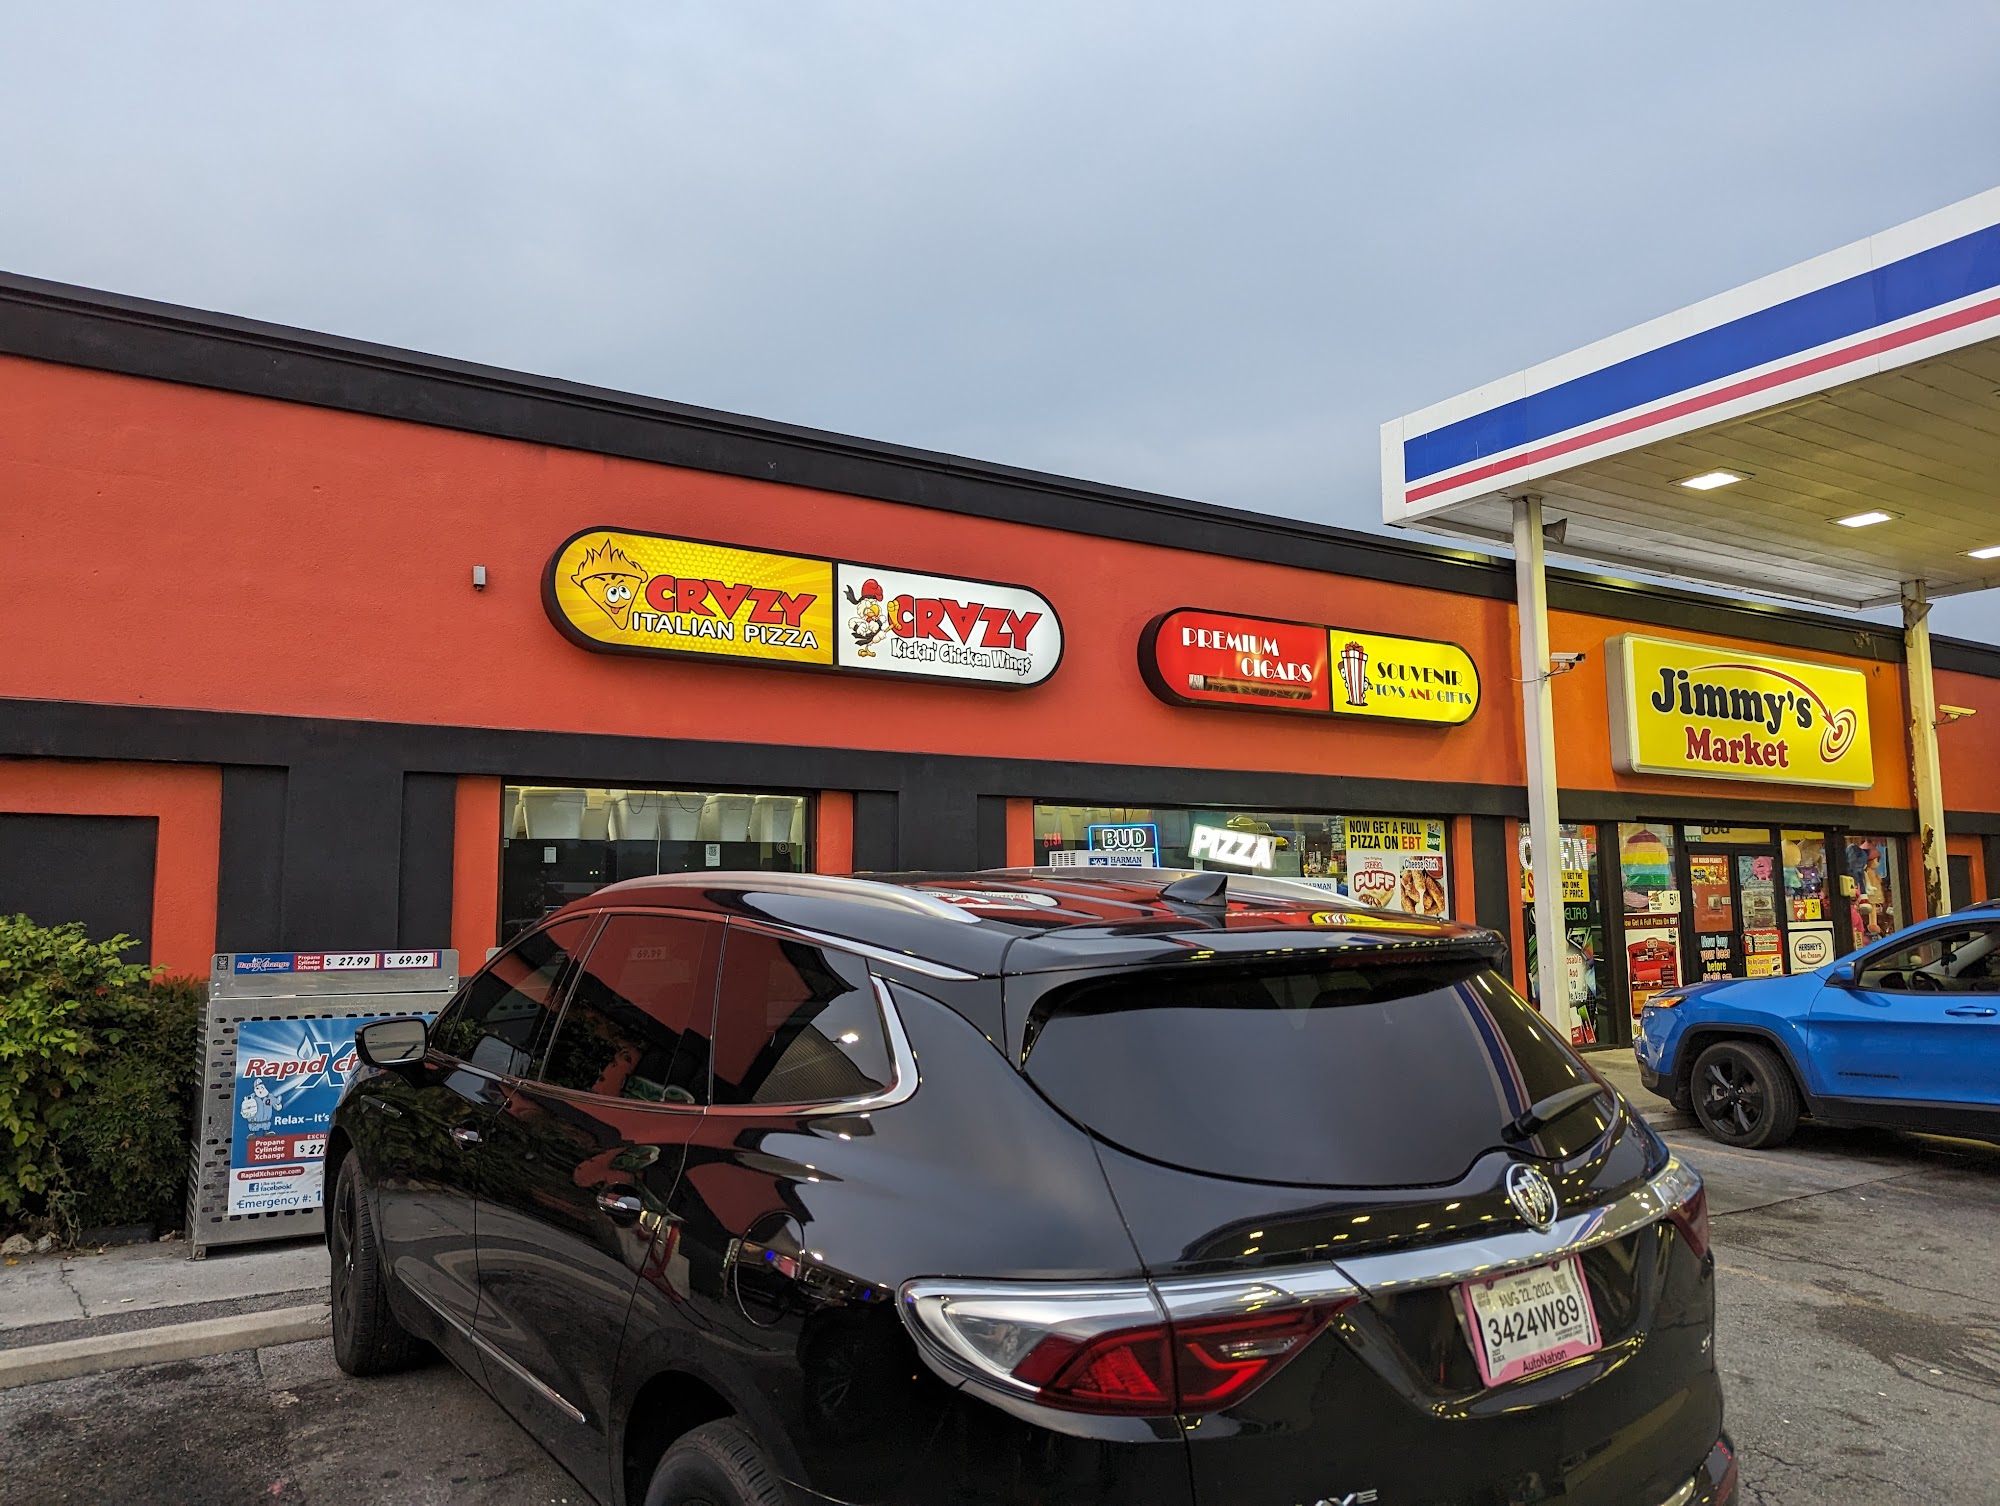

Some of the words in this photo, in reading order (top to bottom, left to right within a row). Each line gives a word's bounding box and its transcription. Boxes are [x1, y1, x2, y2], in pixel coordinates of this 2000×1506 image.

[645, 575, 817, 627] CRAZY
[632, 612, 734, 641] ITALIAN
[744, 625, 818, 649] PIZZA
[889, 594, 1042, 651] CRAZY
[1182, 627, 1279, 656] PREMIUM
[890, 637, 938, 661] Kickin'
[938, 643, 991, 668] Chicken
[991, 650, 1032, 676] Wings
[1241, 658, 1313, 683] CIGARS
[1377, 662, 1463, 687] SOUVENIR
[1374, 683, 1406, 699] TOYS
[1407, 687, 1434, 701] AND
[1436, 690, 1472, 705] GIFTS
[1651, 668, 1812, 735] Jimmy's
[1685, 726, 1789, 768] Market
[1349, 820, 1370, 834] NOW
[1373, 821, 1389, 834] GET
[1392, 822, 1398, 834] A
[1401, 822, 1421, 835] FULL
[1102, 828, 1146, 848] BUD
[1192, 826, 1271, 869] PIZZA
[1350, 835, 1381, 849] PIZZA
[1384, 835, 1398, 850] ON
[1402, 836, 1421, 850] EBT
[1426, 836, 1440, 845] SNAP
[1518, 836, 1589, 871] OEN
[1404, 859, 1424, 869] Cheese
[1424, 858, 1438, 870] Stick
[1354, 871, 1396, 893] PUFF
[1565, 907, 1581, 921] ELTA
[1582, 907, 1588, 920] 8
[1716, 935, 1728, 948] buy
[325, 957, 332, 967] $
[338, 956, 371, 966] 27.99
[386, 956, 392, 965] $
[398, 955, 429, 965] 69.99
[1700, 949, 1715, 963] your
[1716, 947, 1731, 960] beer
[1706, 961, 1727, 971] before
[254, 1145, 285, 1154] Cylinder
[255, 1139, 285, 1148] Propane
[299, 1144, 305, 1153] $
[254, 1152, 285, 1161] Xchange
[240, 1168, 302, 1179] RapidXchange.com
[237, 1196, 300, 1209] Emergency
[1499, 1291, 1519, 1308] AUG
[1519, 1288, 1535, 1303] 22,
[1532, 1281, 1554, 1298] 2023
[1488, 1294, 1580, 1347] 3424W89
[1522, 1349, 1567, 1373] AutoNation
